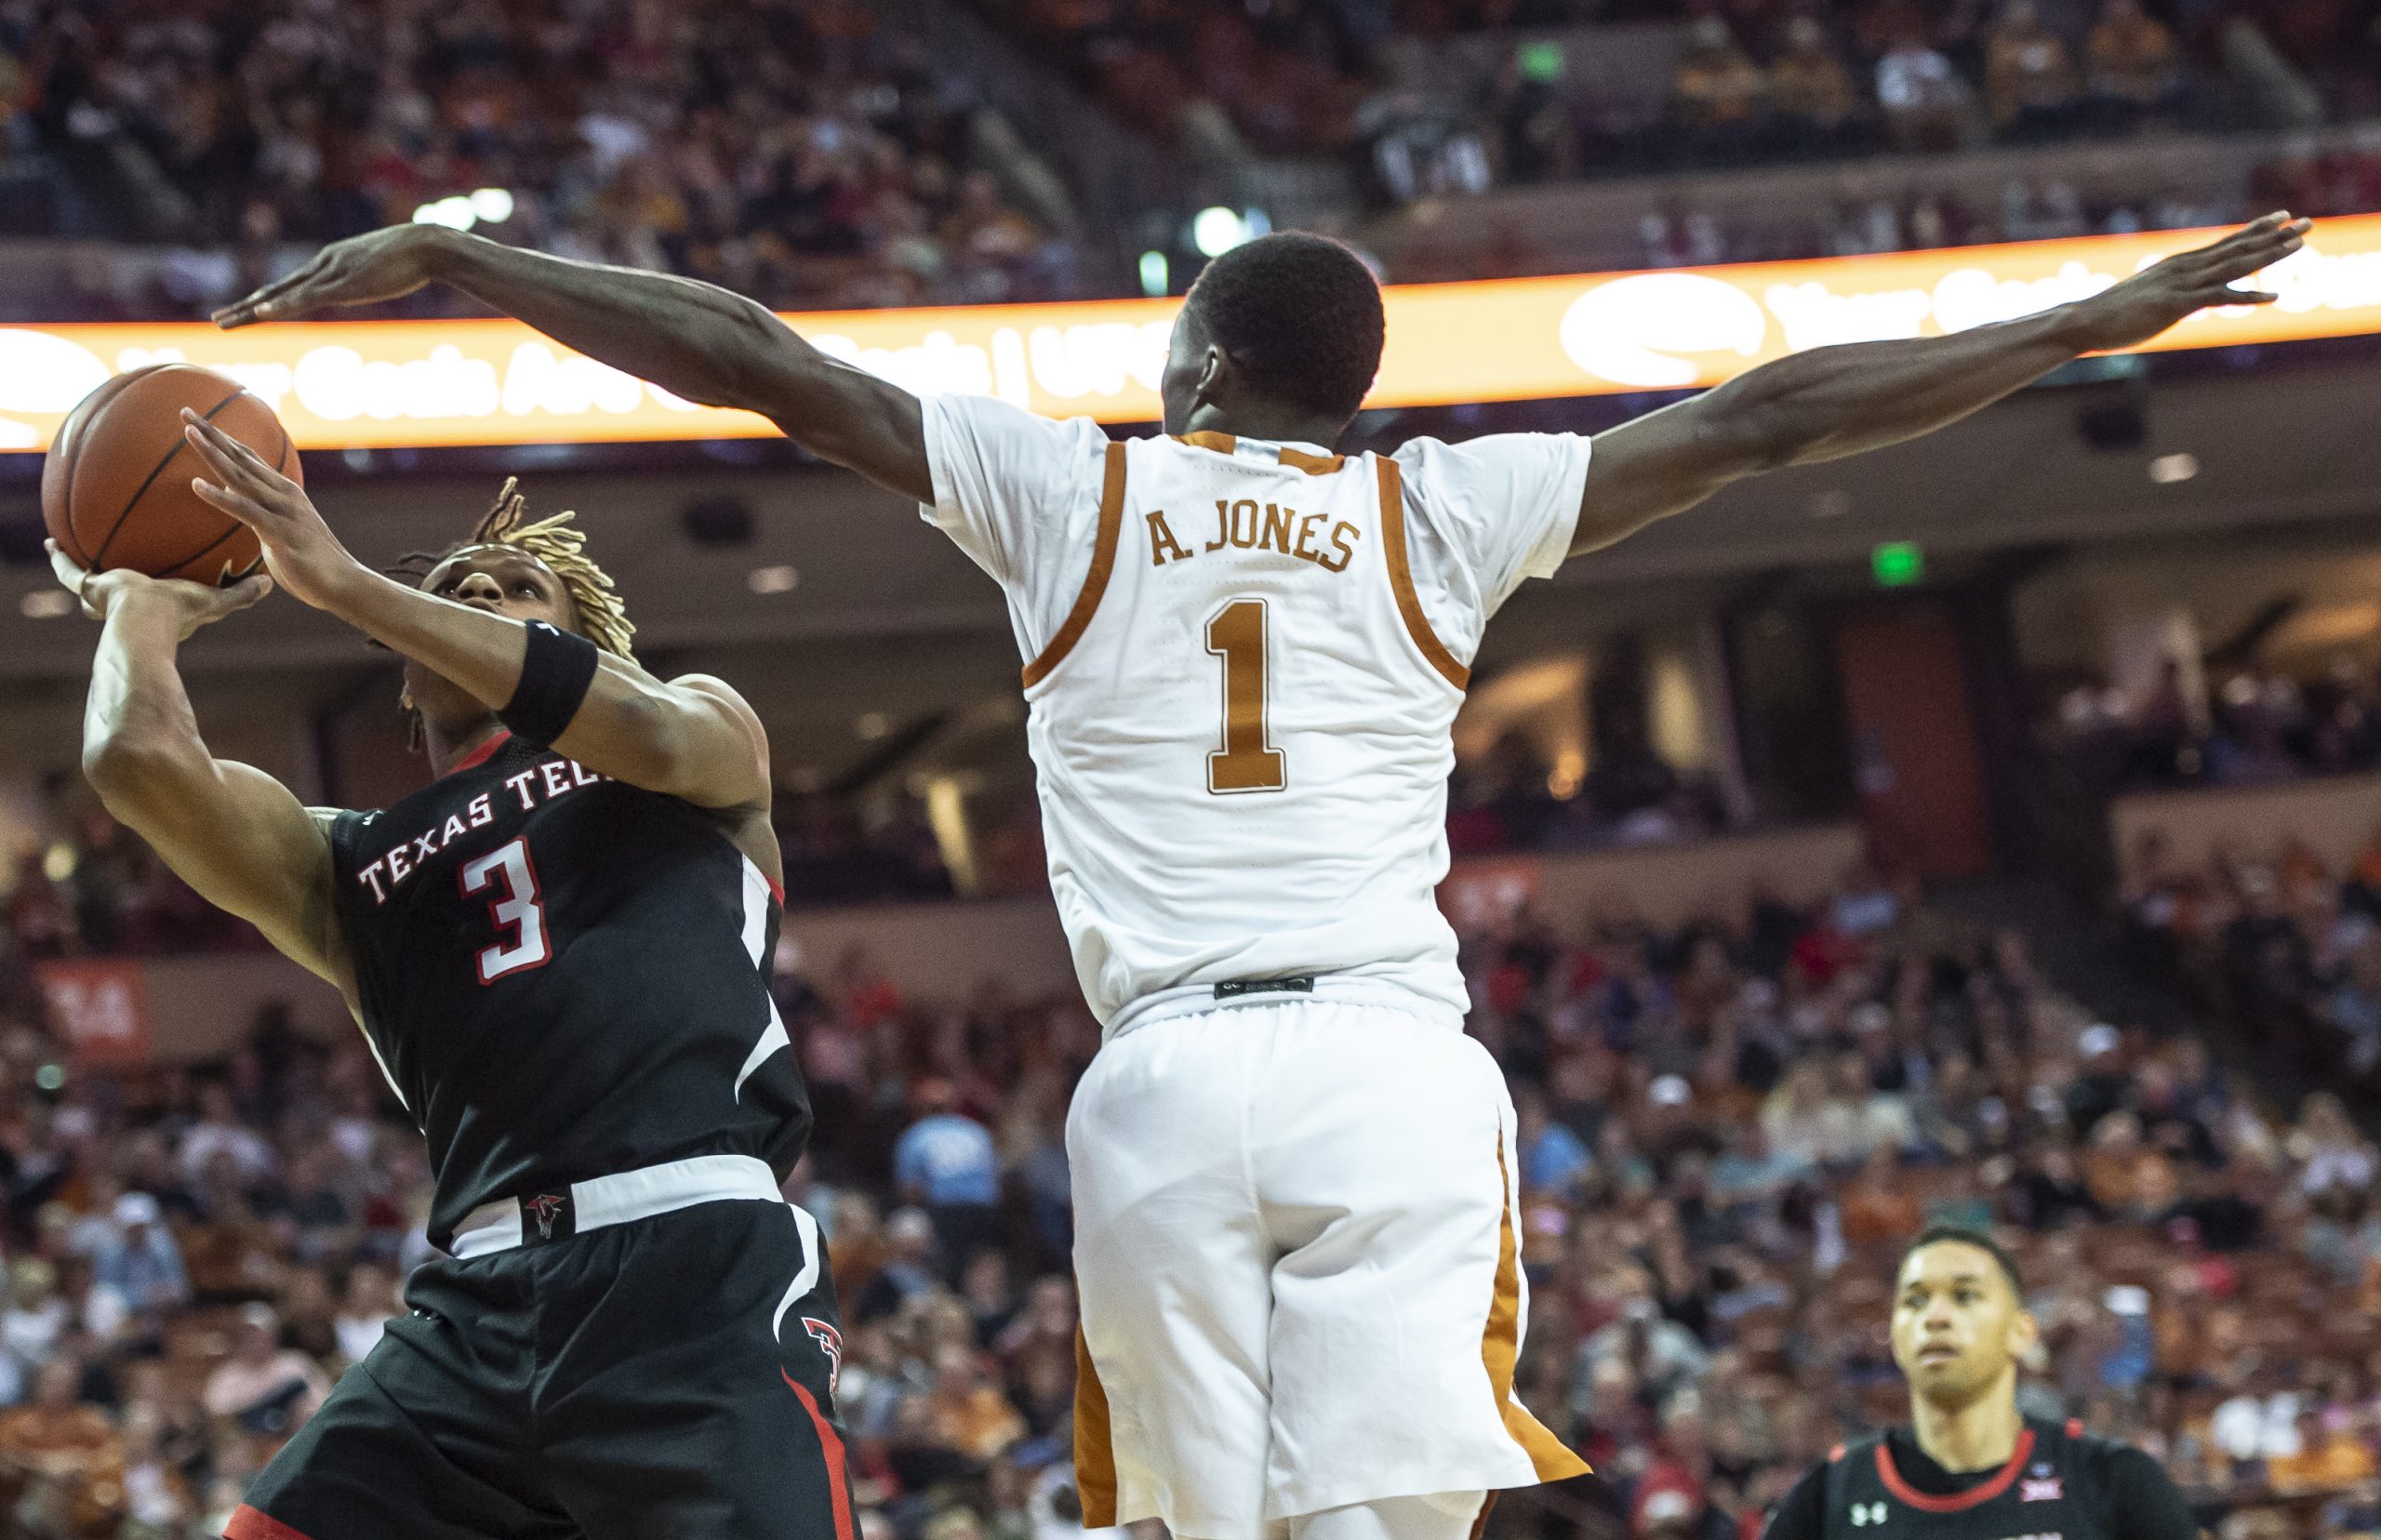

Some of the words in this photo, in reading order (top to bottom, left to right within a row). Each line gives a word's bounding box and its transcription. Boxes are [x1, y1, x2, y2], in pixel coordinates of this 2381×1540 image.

[1145, 510, 1193, 567] A.
[1204, 498, 1361, 574] JONES
[1204, 597, 1287, 795] 1
[356, 791, 494, 906] TEXAS
[458, 835, 552, 987] 3
